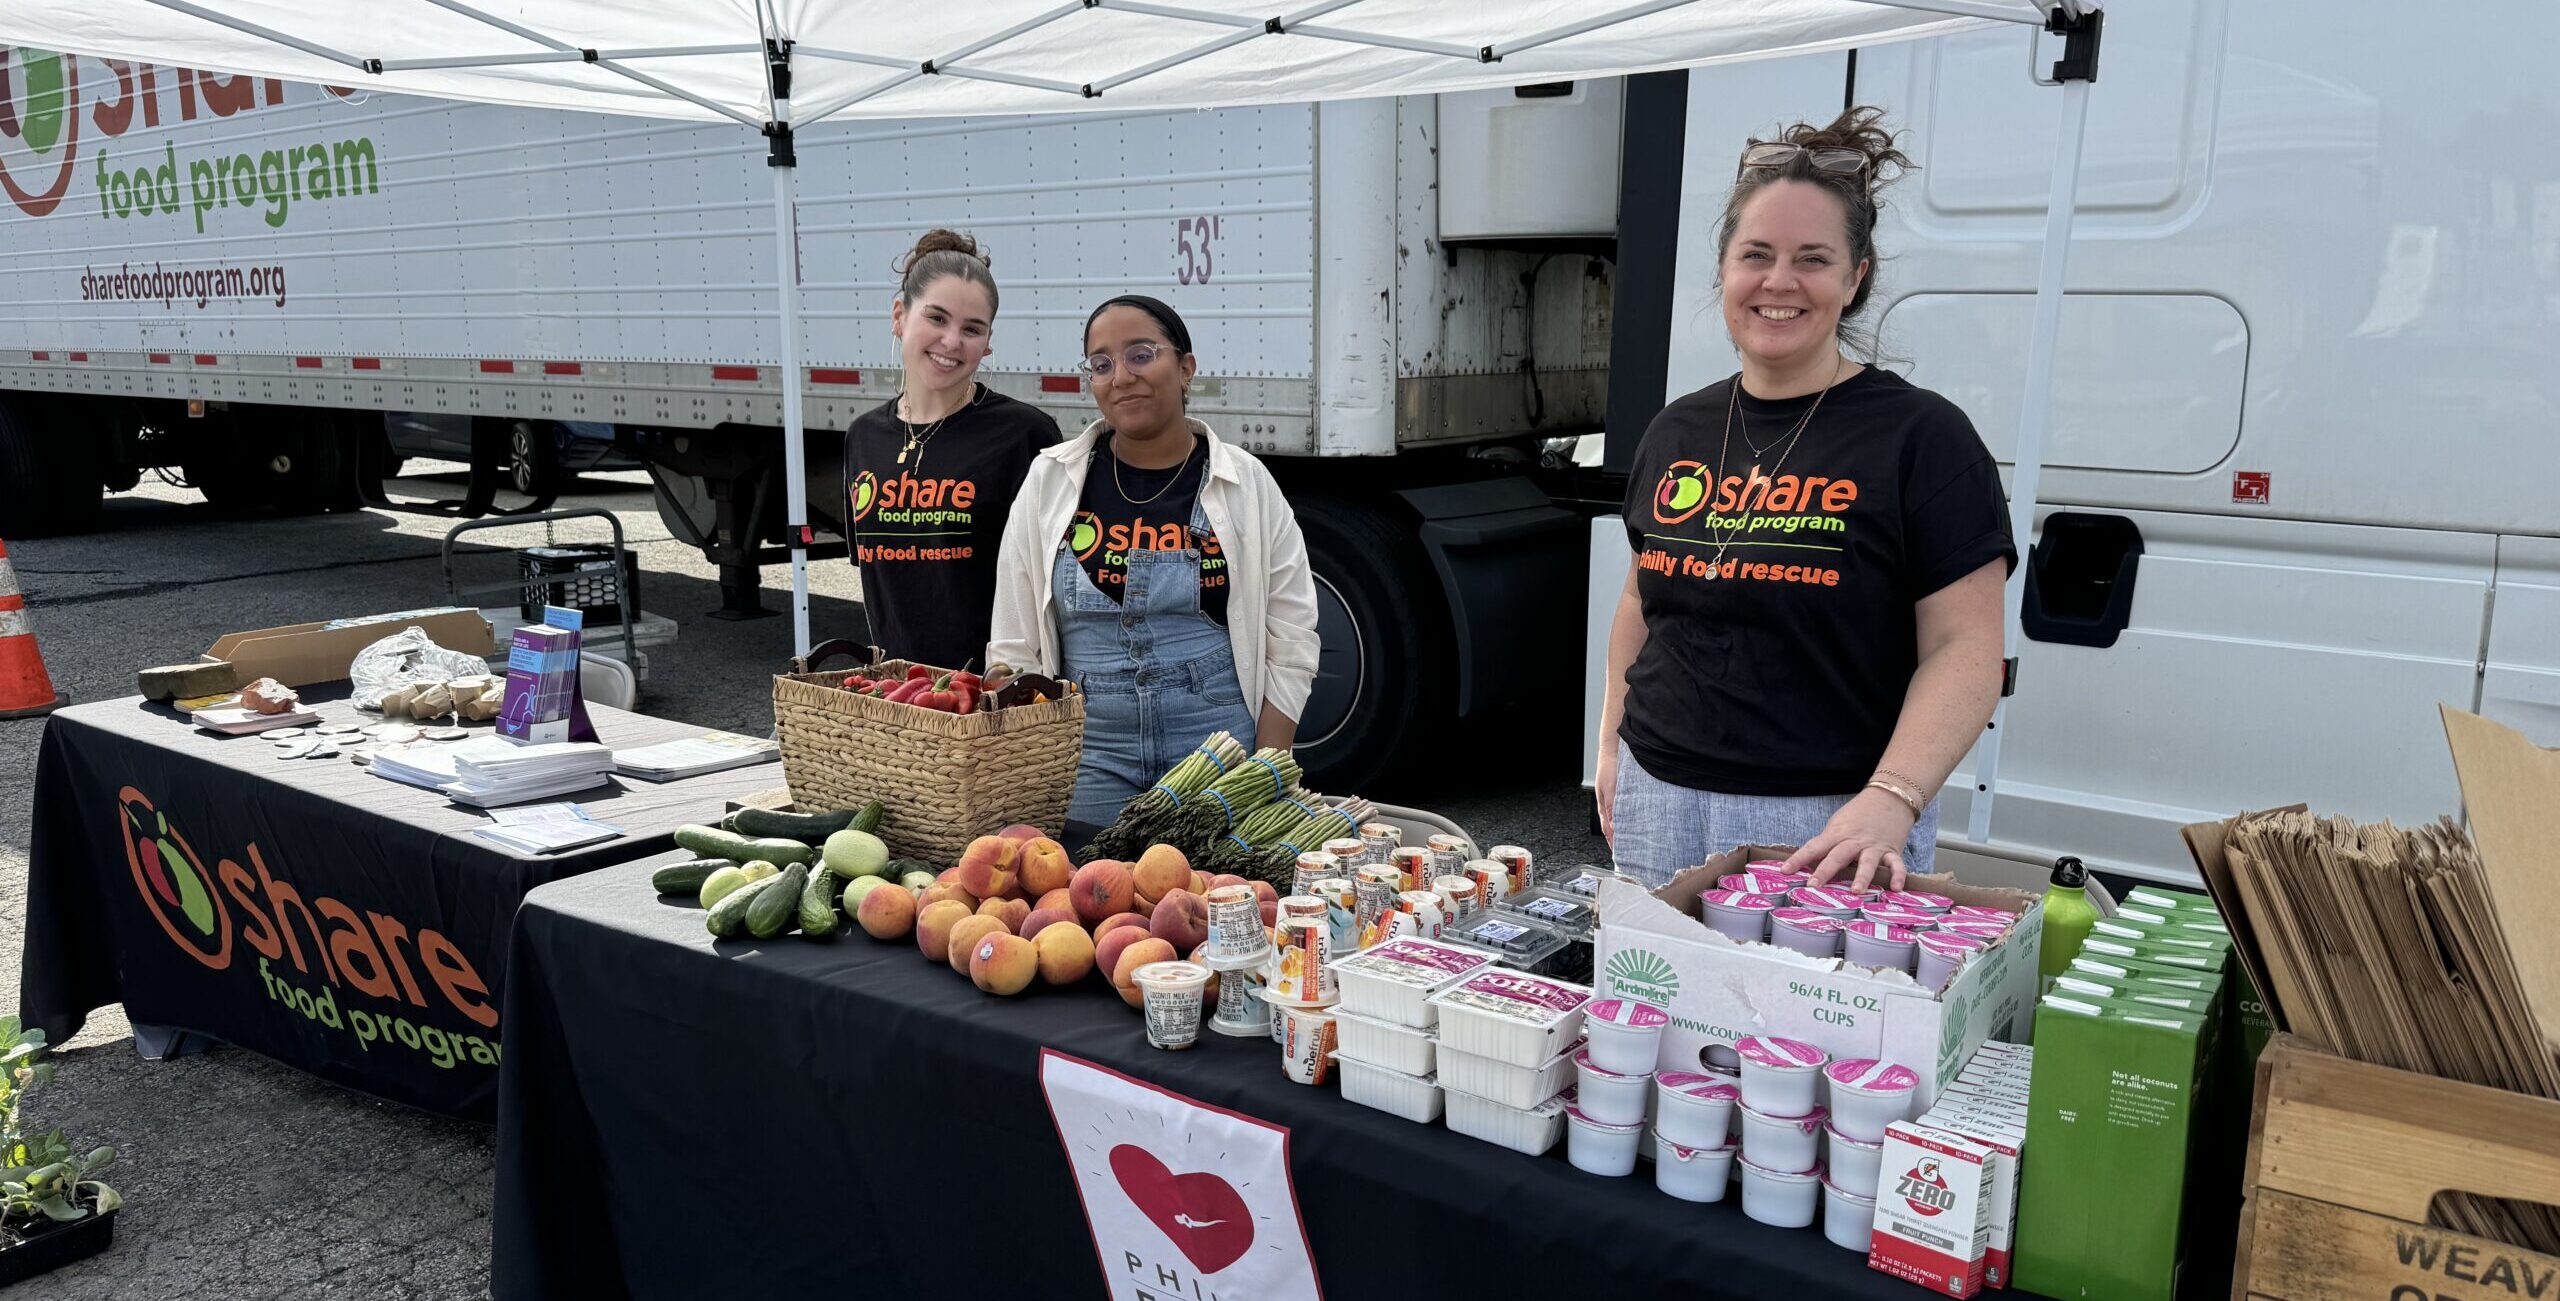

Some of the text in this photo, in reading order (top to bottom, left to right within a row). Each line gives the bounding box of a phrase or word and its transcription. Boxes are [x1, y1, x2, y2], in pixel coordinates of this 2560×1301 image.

[96, 136, 379, 234] food program
[1177, 215, 1219, 286] 53'
[81, 262, 287, 309] sharefoodprogram.org
[878, 470, 976, 509] share
[1711, 464, 1858, 513] share
[878, 508, 972, 526] food program
[1705, 511, 1845, 533] food program
[876, 544, 917, 561] food
[920, 546, 973, 561] rescue
[1683, 554, 1738, 580] fod
[1740, 562, 1840, 587] rescue
[218, 841, 499, 1028] share
[259, 956, 344, 1030] food
[1789, 981, 1882, 1013] 96/4 FL. OZ.
[1813, 1007, 1855, 1028] CUPS
[2112, 1070, 2128, 1080] Not
[1895, 1175, 1956, 1211] ZERO
[1902, 1226, 1921, 1239] FRUIT
[1921, 1233, 1944, 1246] PUNCH
[2397, 1231, 2556, 1299] WEAV
